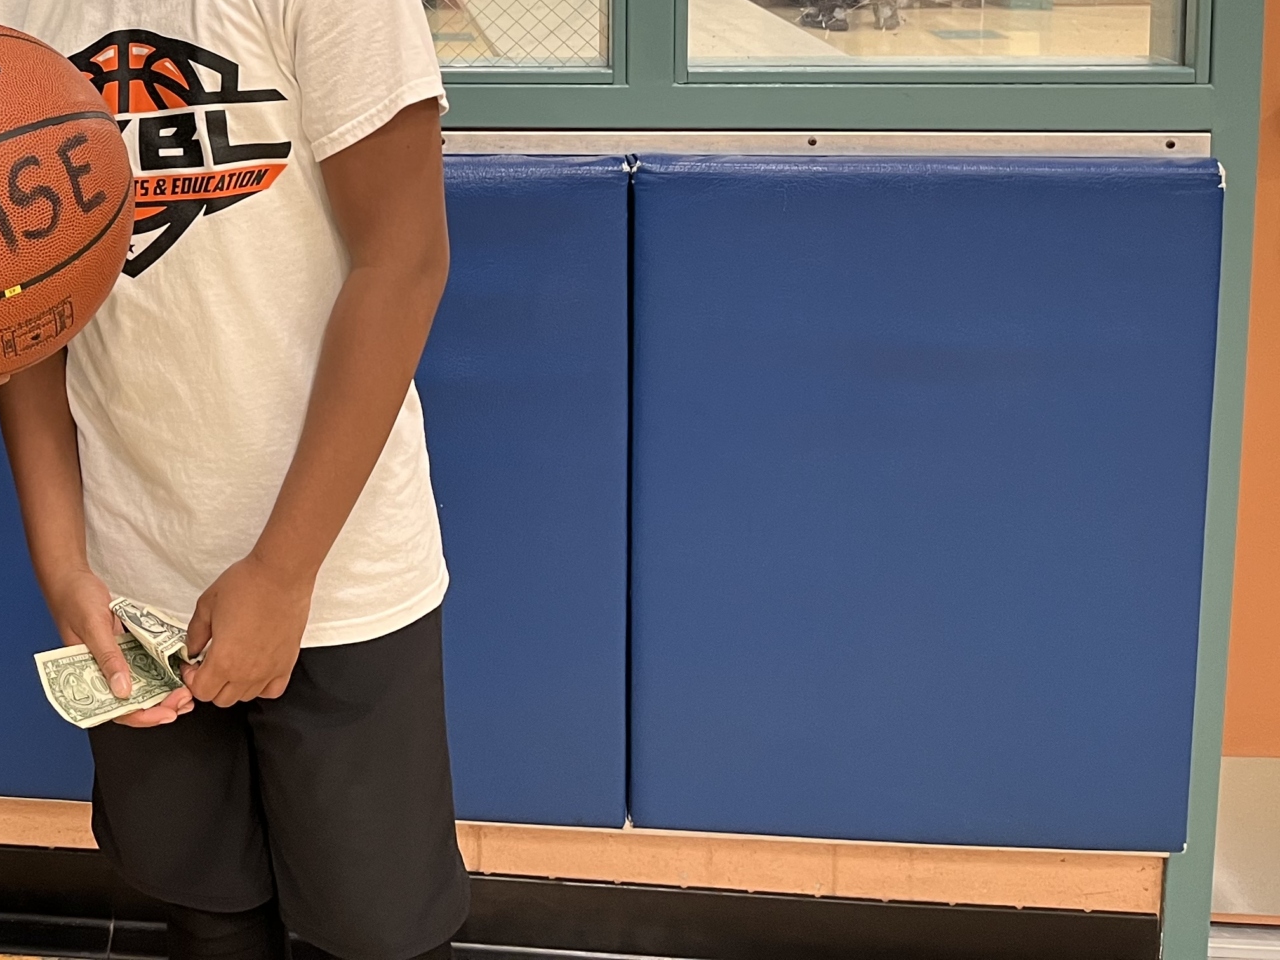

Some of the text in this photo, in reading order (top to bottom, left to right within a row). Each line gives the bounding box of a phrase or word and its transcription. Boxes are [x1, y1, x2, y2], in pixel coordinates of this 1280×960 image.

[117, 111, 291, 171] BL
[153, 178, 167, 196] &
[170, 168, 269, 195] EDUCATION
